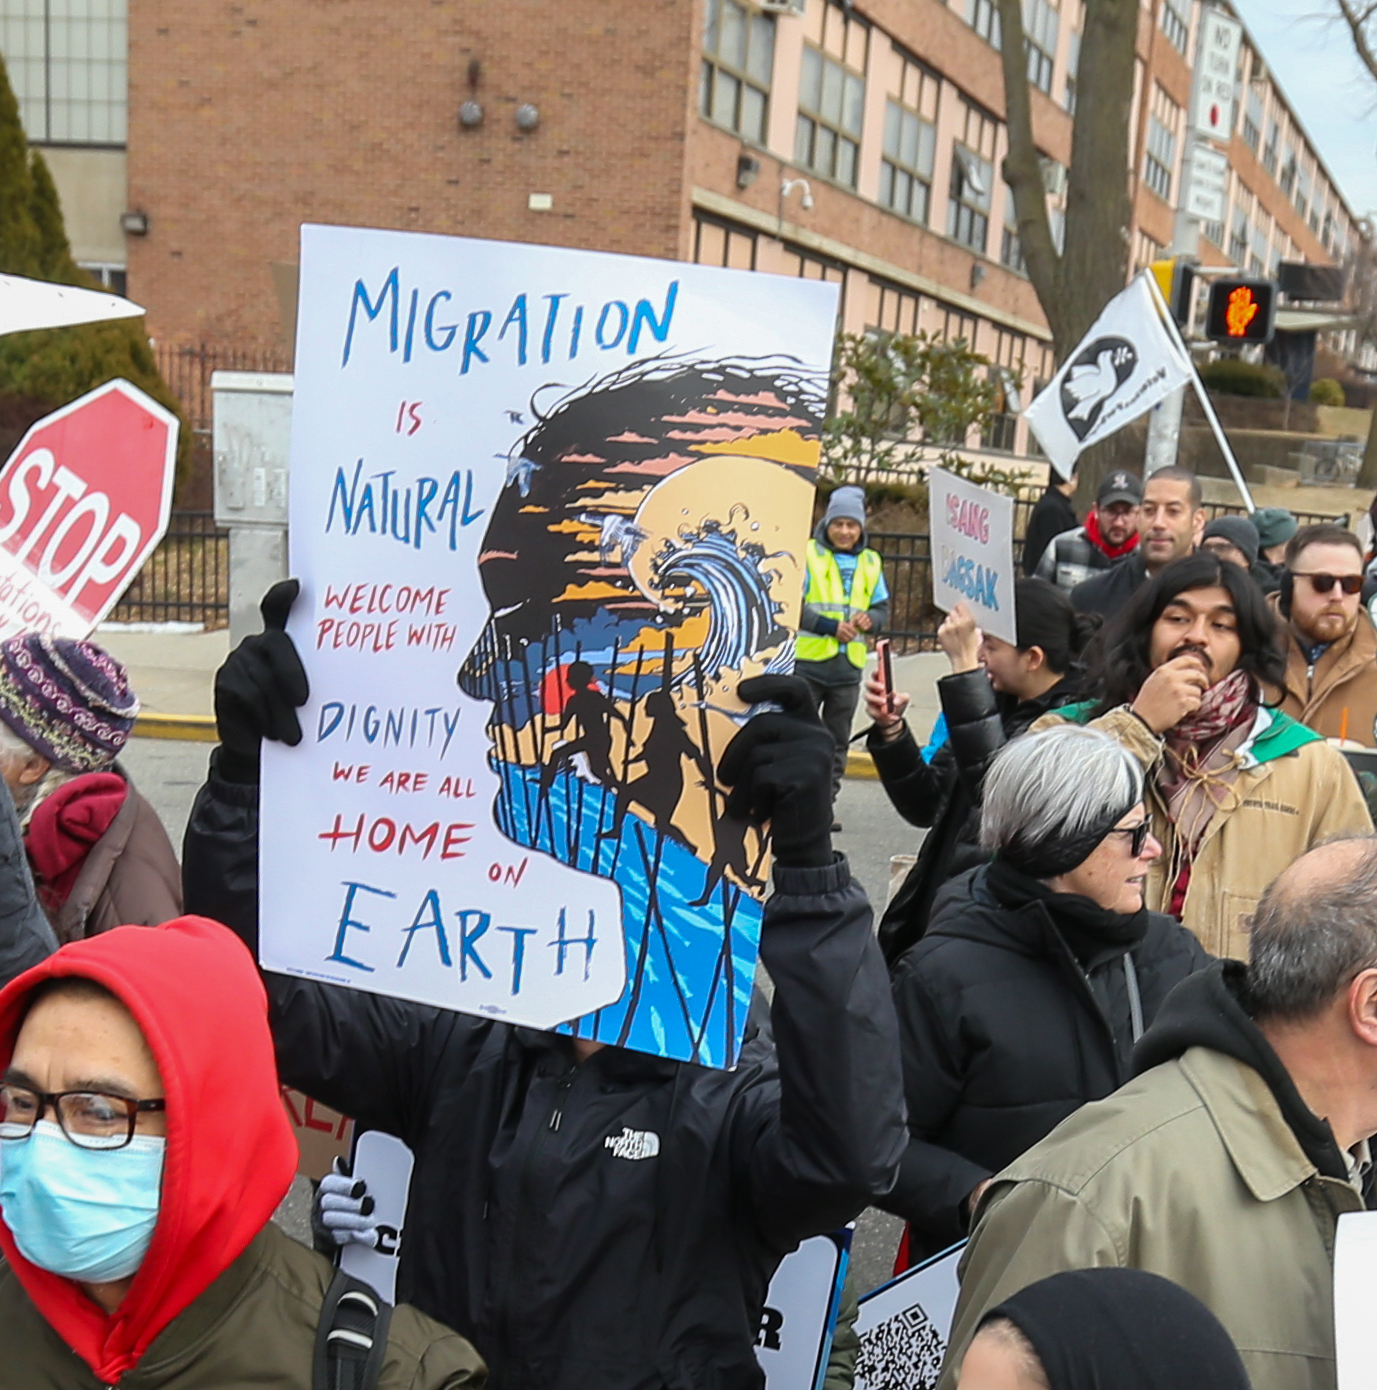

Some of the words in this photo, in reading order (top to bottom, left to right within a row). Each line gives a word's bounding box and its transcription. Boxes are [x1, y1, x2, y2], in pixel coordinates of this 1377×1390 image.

[342, 266, 679, 376] MIGRATION
[395, 399, 424, 437] IS
[324, 457, 490, 551] NATURAL
[324, 583, 452, 617] WELCOME
[316, 618, 400, 653] PEOPLE
[406, 622, 458, 652] WITH
[316, 701, 462, 761] DIGNITY
[331, 760, 372, 784] WE
[378, 770, 430, 794] ARE
[438, 775, 478, 799] ALL
[317, 812, 474, 863] HOME
[487, 855, 529, 889] ON
[325, 880, 599, 996] EARTH
